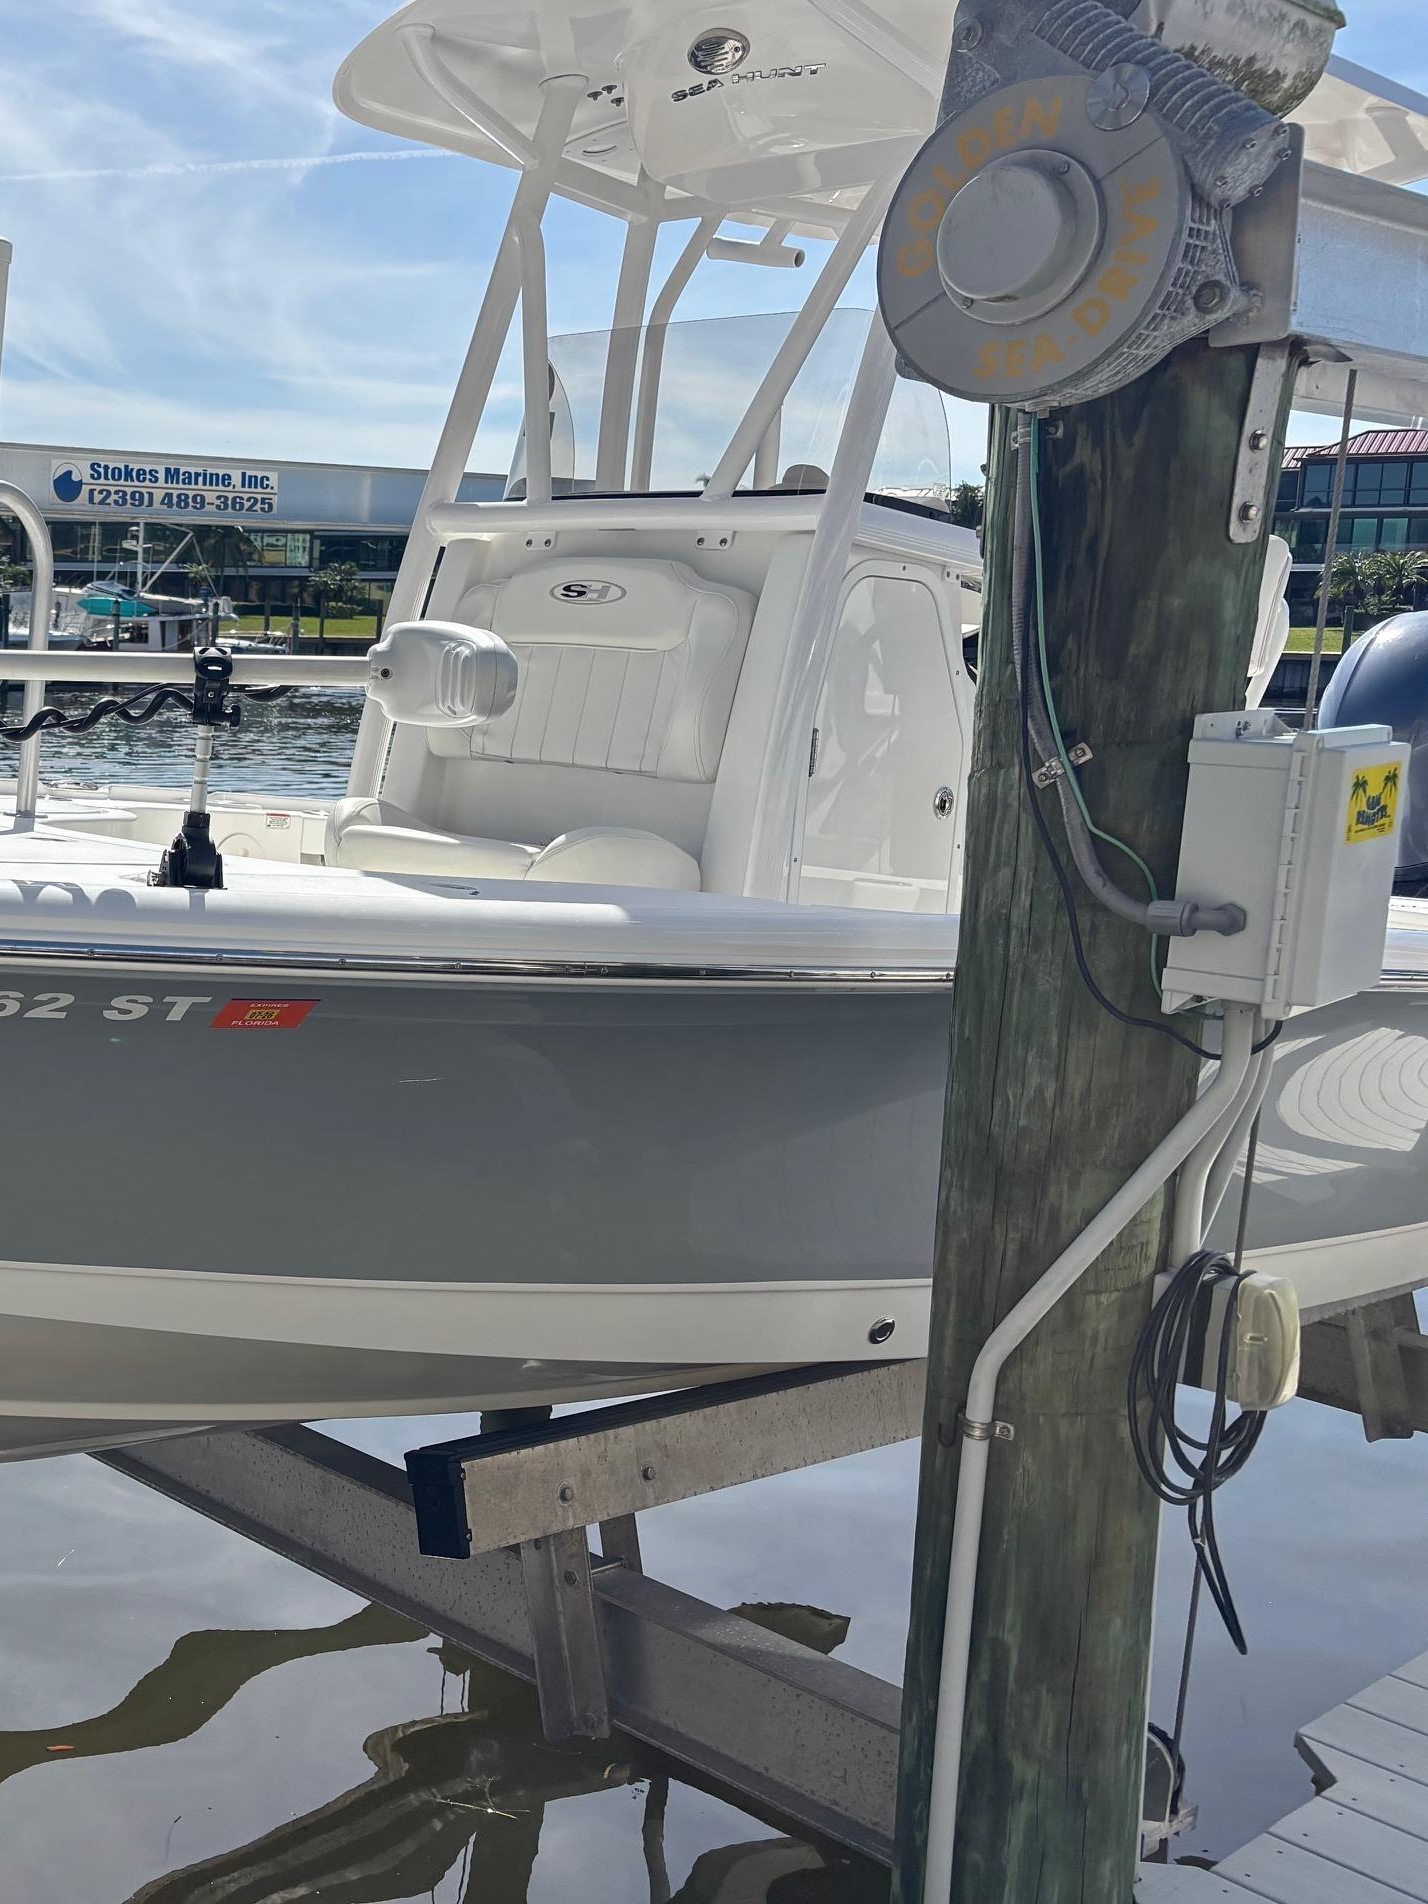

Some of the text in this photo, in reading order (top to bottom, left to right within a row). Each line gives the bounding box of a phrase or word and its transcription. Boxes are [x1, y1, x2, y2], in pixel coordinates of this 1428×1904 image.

[671, 63, 827, 102] SEA HUNT
[896, 96, 1063, 278] GOLDEN
[974, 176, 1160, 380] SEA-DRIVE
[89, 462, 274, 490] Stokes Marine, Inc.
[160, 492, 274, 513] 489-3625
[102, 994, 212, 1021] ST
